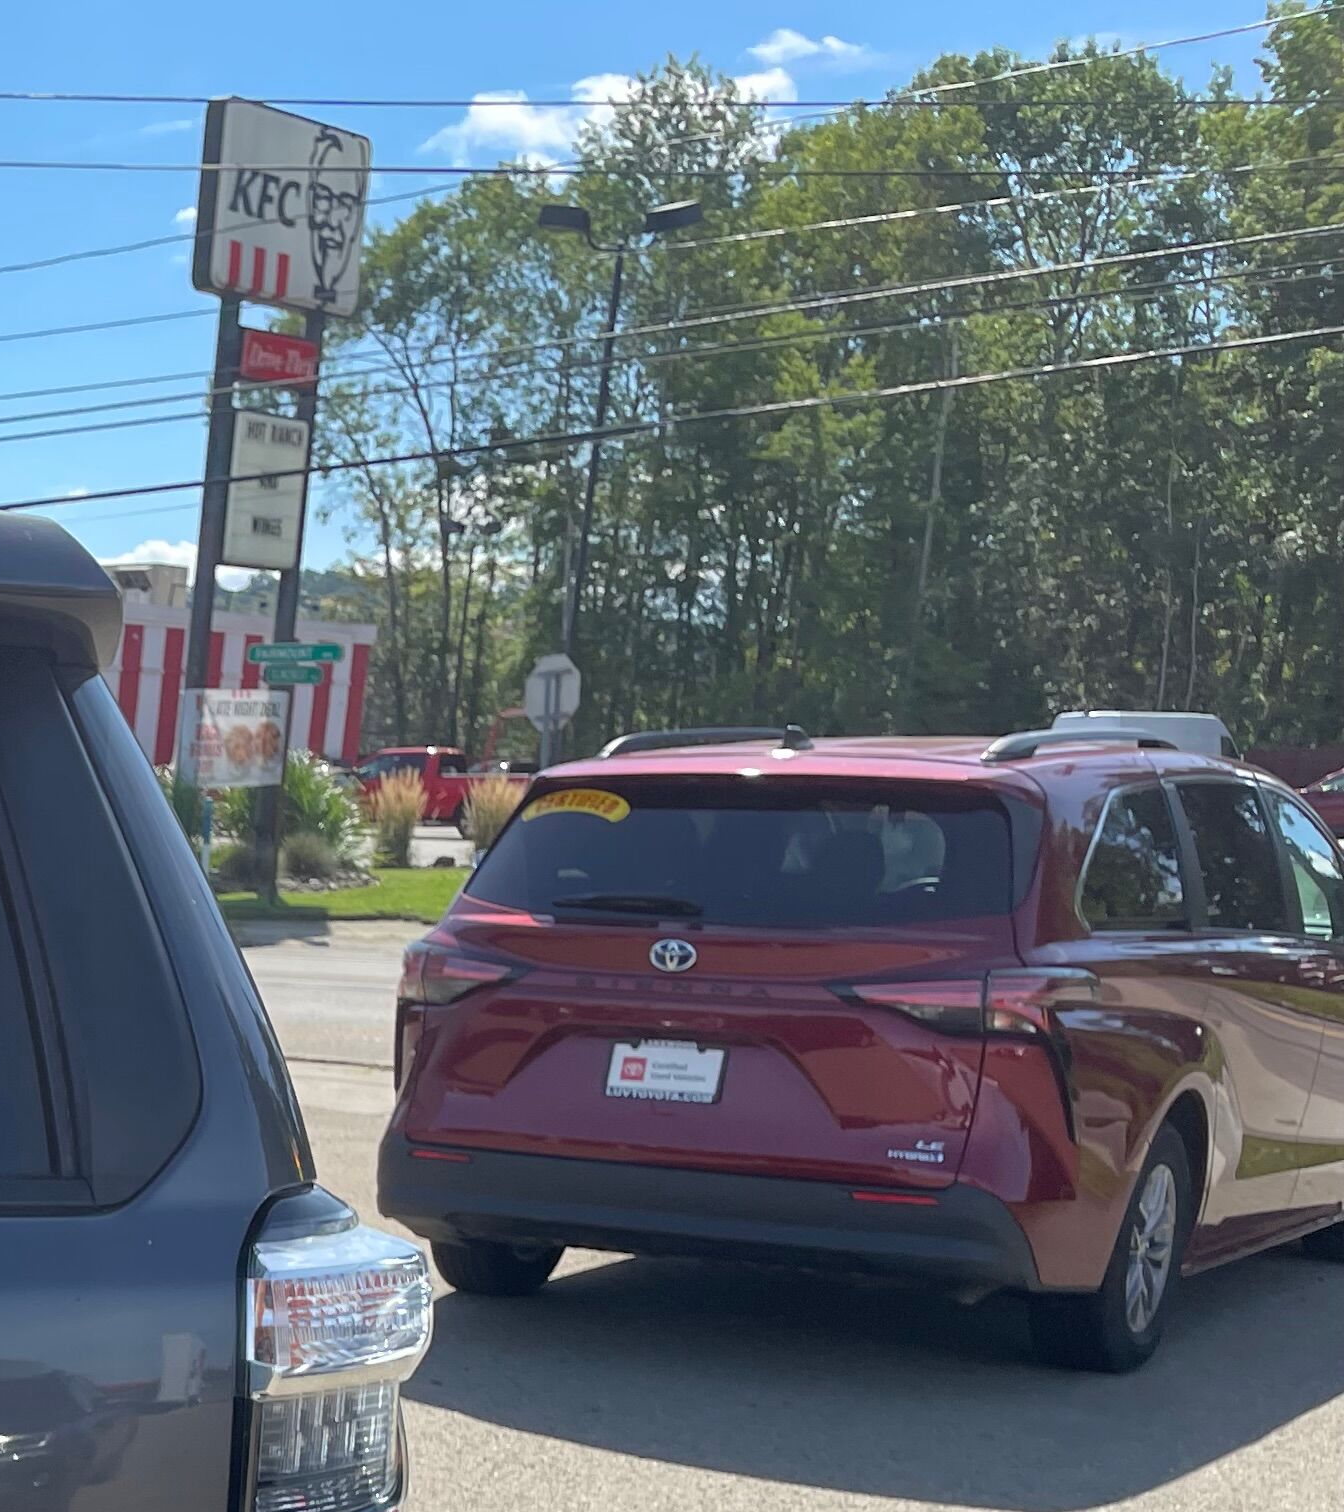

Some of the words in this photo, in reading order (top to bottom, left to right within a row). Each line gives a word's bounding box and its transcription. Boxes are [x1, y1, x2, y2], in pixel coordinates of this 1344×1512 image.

[229, 168, 301, 229] KFC
[247, 420, 267, 441] HOT
[575, 974, 770, 998] SIENNA
[606, 1086, 713, 1104] LUVTOYOTA.COM
